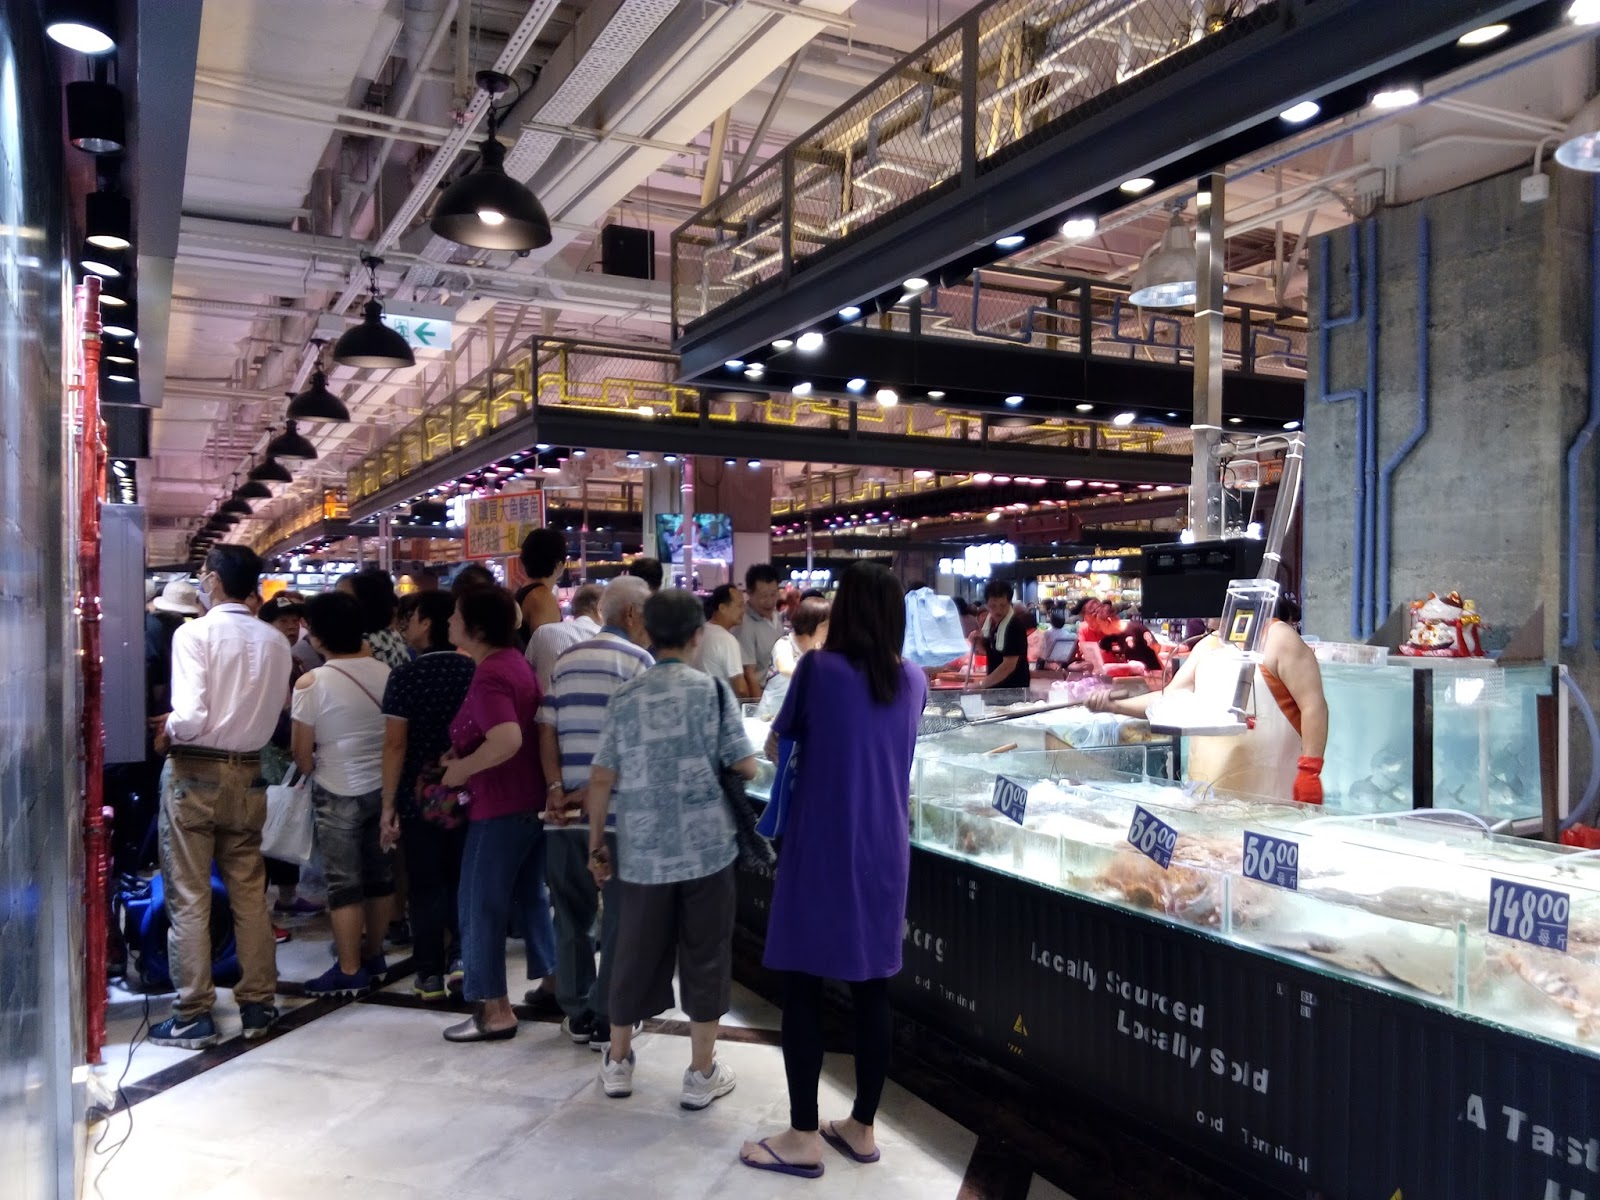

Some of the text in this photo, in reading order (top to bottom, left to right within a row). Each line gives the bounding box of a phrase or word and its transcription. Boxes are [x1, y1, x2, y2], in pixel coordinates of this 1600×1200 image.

[1030, 941, 1205, 1029] Locally Sourced
[1116, 1009, 1270, 1094] Locally Sold
